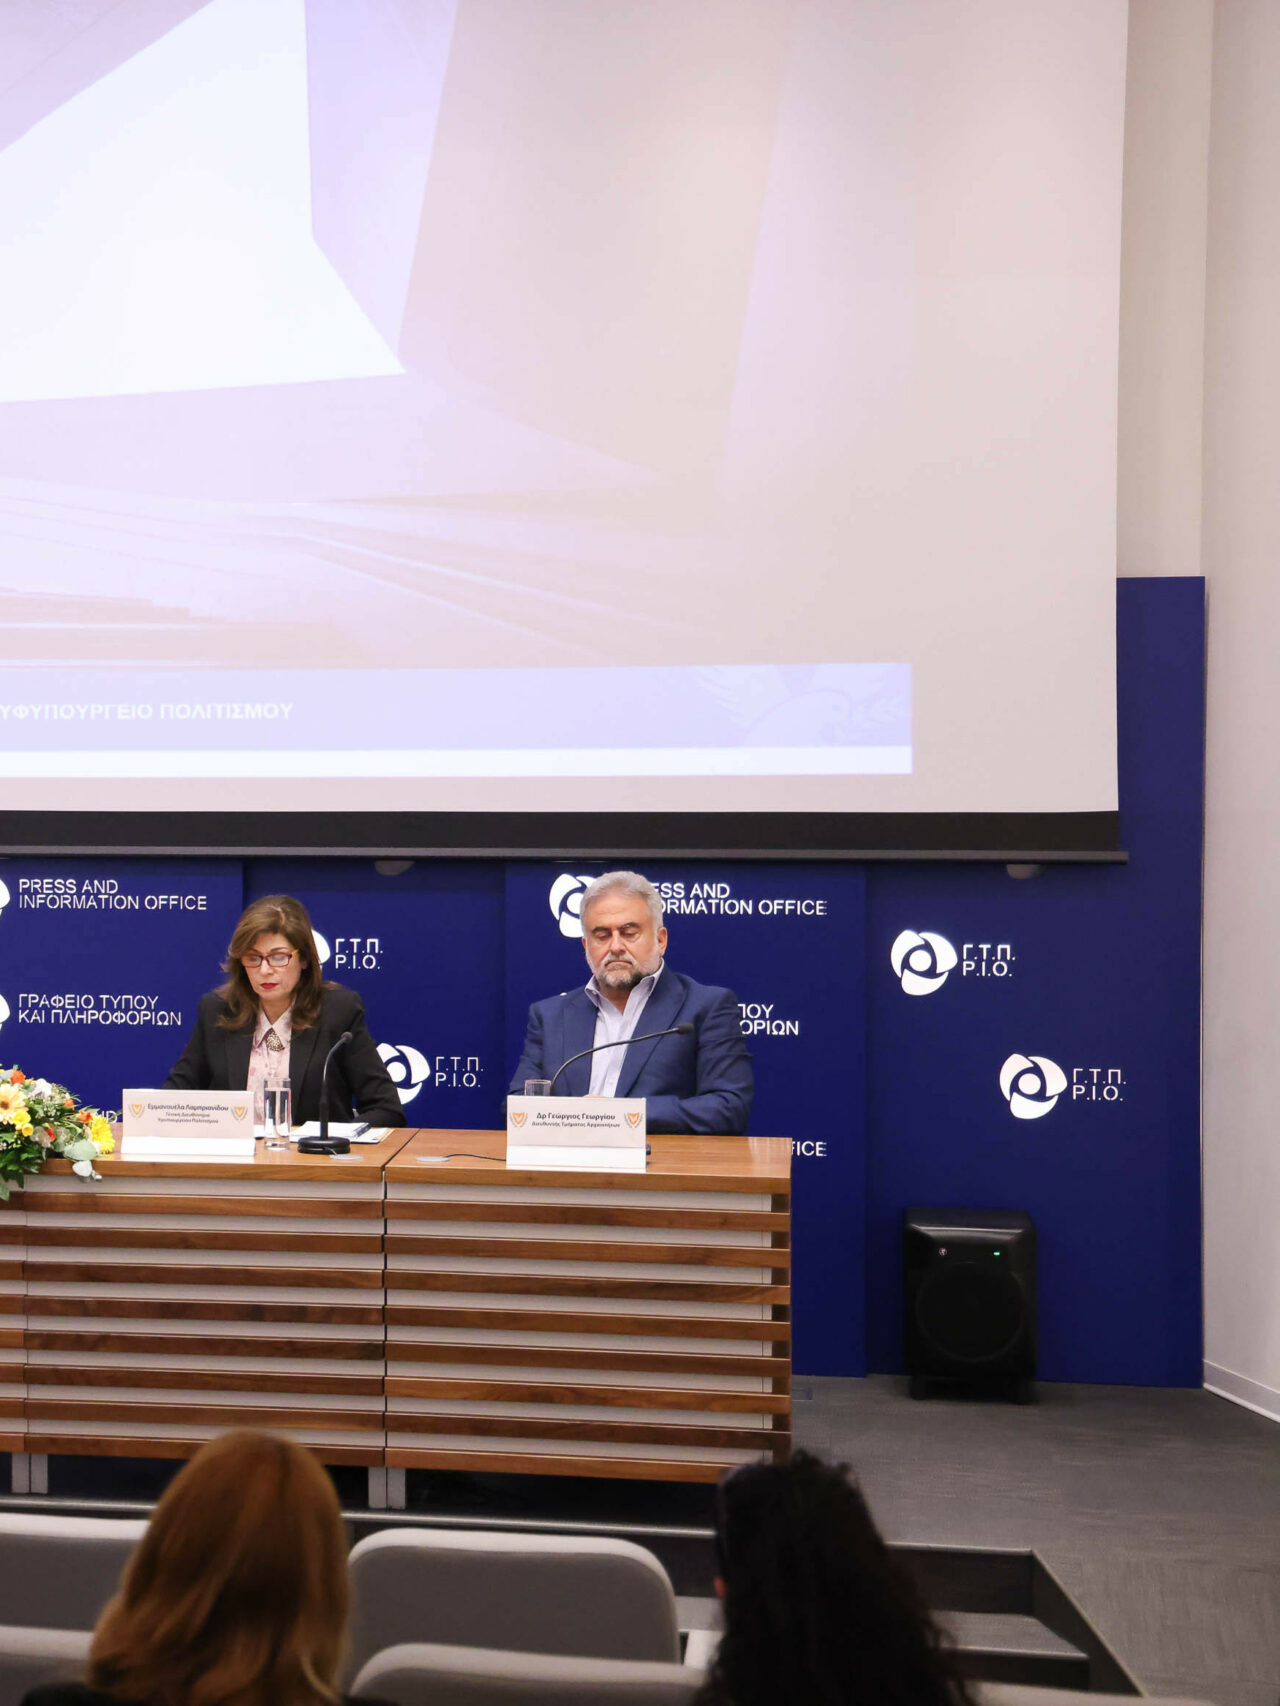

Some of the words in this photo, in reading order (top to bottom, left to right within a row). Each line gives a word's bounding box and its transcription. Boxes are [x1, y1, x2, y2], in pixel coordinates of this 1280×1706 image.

[159, 702, 294, 720] ΠΟΛΙΤΙΣΜΟΥ
[19, 879, 77, 894] PRESS
[81, 879, 119, 894] AND
[690, 883, 731, 899] AND
[19, 894, 139, 910] INFORMATION
[144, 895, 207, 910] OFFICE
[758, 899, 828, 916] OFFICE
[335, 938, 384, 954] Γ.Τ.Π.
[962, 944, 1016, 961] Γ.Τ.Π.
[335, 954, 381, 970] P.I.O.
[962, 961, 1013, 977] P.I.O.
[18, 993, 95, 1009] ΓΡΑΦΕΙΟ
[99, 994, 159, 1010] ΤΥΠΟΥ
[18, 1009, 46, 1024] ΚΑΙ
[51, 1009, 182, 1026] ΠΛΗΡΟΦΟΡΙΩΝ
[737, 1003, 774, 1019] ΠΟΥ
[435, 1056, 484, 1071] Γ.Τ.Π.
[435, 1072, 481, 1087] P.I.O.
[1072, 1068, 1127, 1085] Γ.Τ.Π.
[1072, 1085, 1124, 1101] P.I.O.
[536, 1112, 547, 1120] Δρ
[547, 1112, 580, 1121] Γεώργιος
[581, 1112, 616, 1121] Γεωργίου
